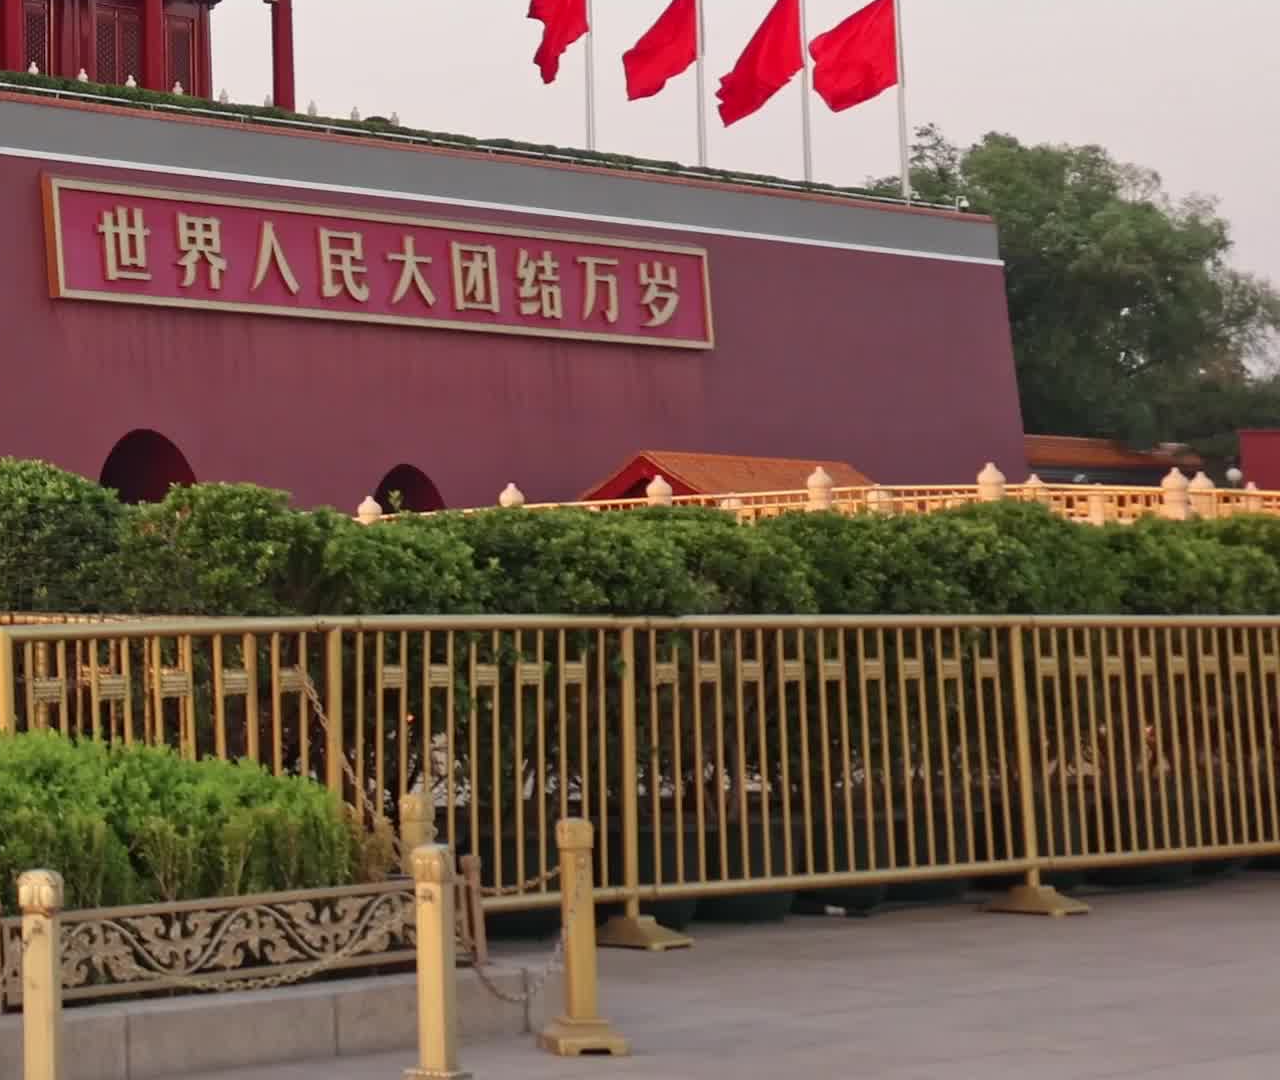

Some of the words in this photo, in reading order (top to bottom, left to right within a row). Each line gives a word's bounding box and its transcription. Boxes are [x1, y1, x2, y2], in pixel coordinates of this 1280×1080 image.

[97, 205, 680, 327] 世界人民大团结万岁
